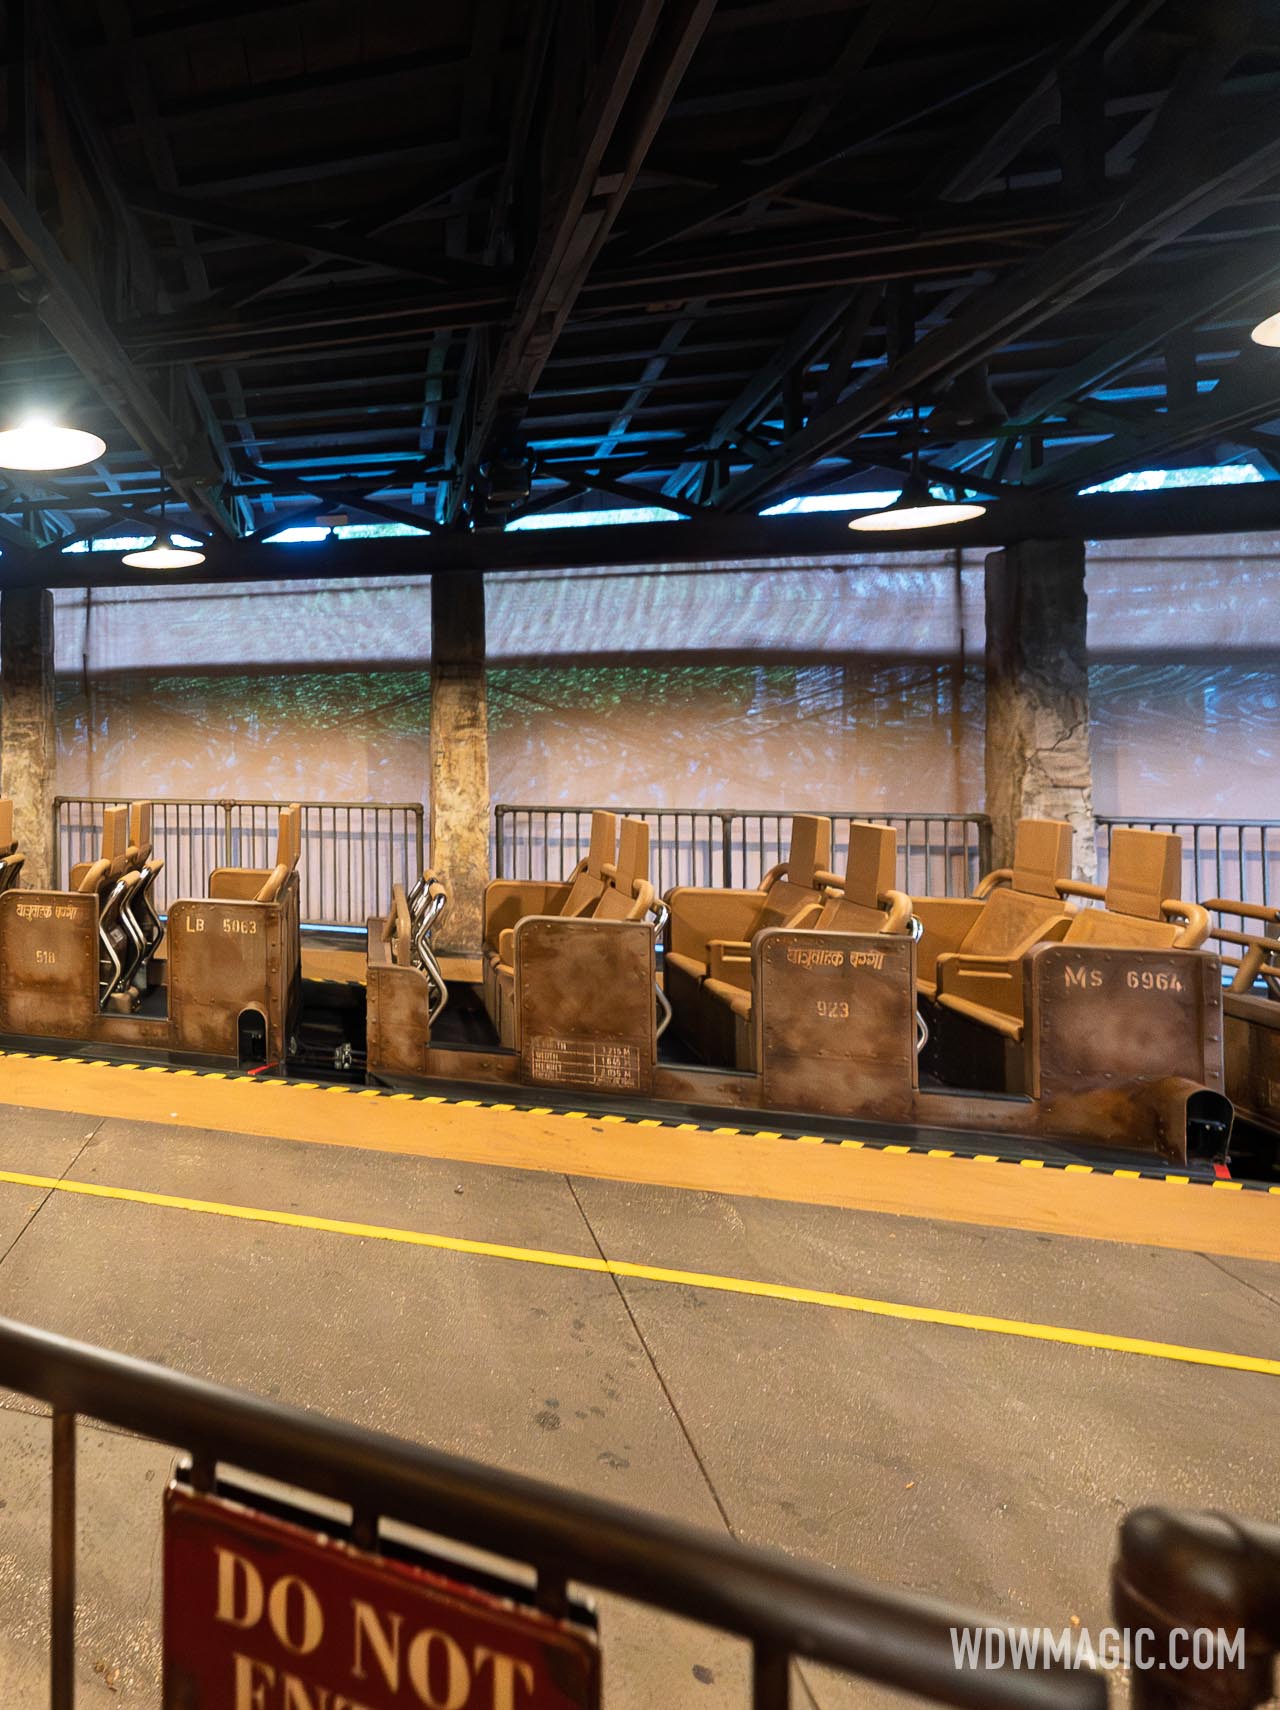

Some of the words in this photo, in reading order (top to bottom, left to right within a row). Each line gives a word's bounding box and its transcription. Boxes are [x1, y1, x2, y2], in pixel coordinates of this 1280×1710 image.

[186, 915, 205, 933] LB
[223, 918, 257, 934] 5063
[1126, 970, 1183, 993] 6964
[816, 1000, 849, 1018] 923
[214, 1546, 324, 1656] DO
[349, 1598, 535, 1710] NOT
